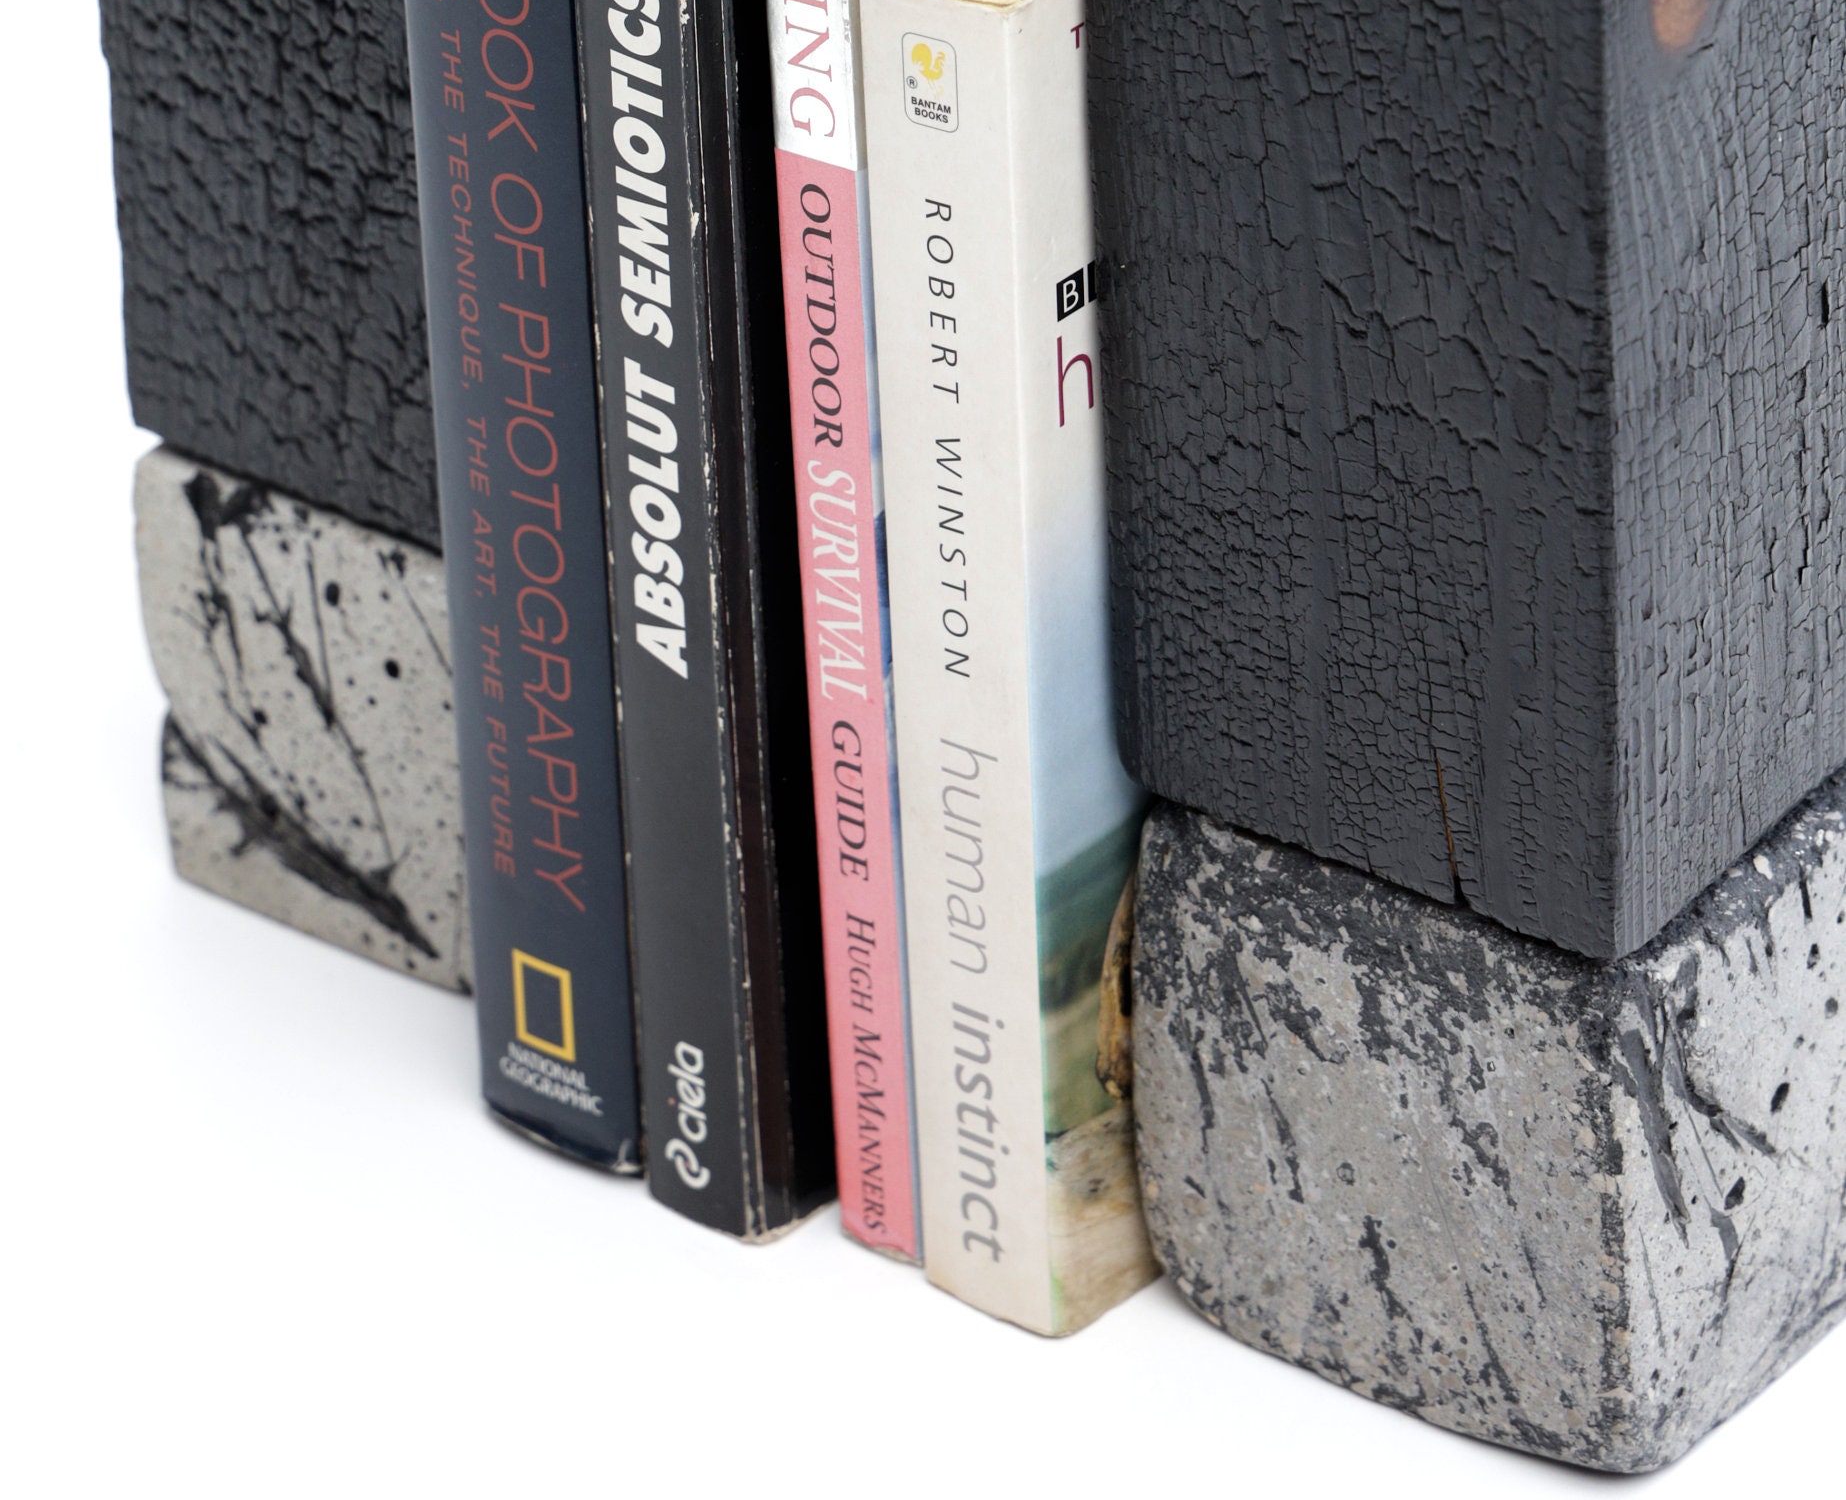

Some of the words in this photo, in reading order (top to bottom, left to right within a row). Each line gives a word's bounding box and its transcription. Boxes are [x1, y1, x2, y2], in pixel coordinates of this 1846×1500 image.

[441, 30, 464, 113] THE
[911, 96, 951, 115] BANTAM
[914, 107, 949, 124] BOOKS
[448, 134, 483, 389] TECHNIQUE,
[490, 172, 547, 289] OF
[925, 198, 960, 403] ROBERT
[800, 183, 844, 448] OUTDOOR
[466, 417, 491, 497] THE
[623, 357, 688, 679] ABSOLUT
[472, 511, 496, 597] ART,
[498, 301, 586, 912] PHOTOGRAPHY
[807, 460, 869, 700] SURVIVAL
[935, 437, 970, 678] WINSTON
[480, 625, 504, 701] THE
[486, 716, 516, 877] FUTURE
[831, 720, 869, 881] GUIDE
[940, 737, 998, 975] human
[846, 911, 876, 1014] HUGH
[508, 1041, 590, 1092] NATIONAL
[667, 1040, 708, 1144] ciela
[950, 1002, 1011, 1263] instinct
